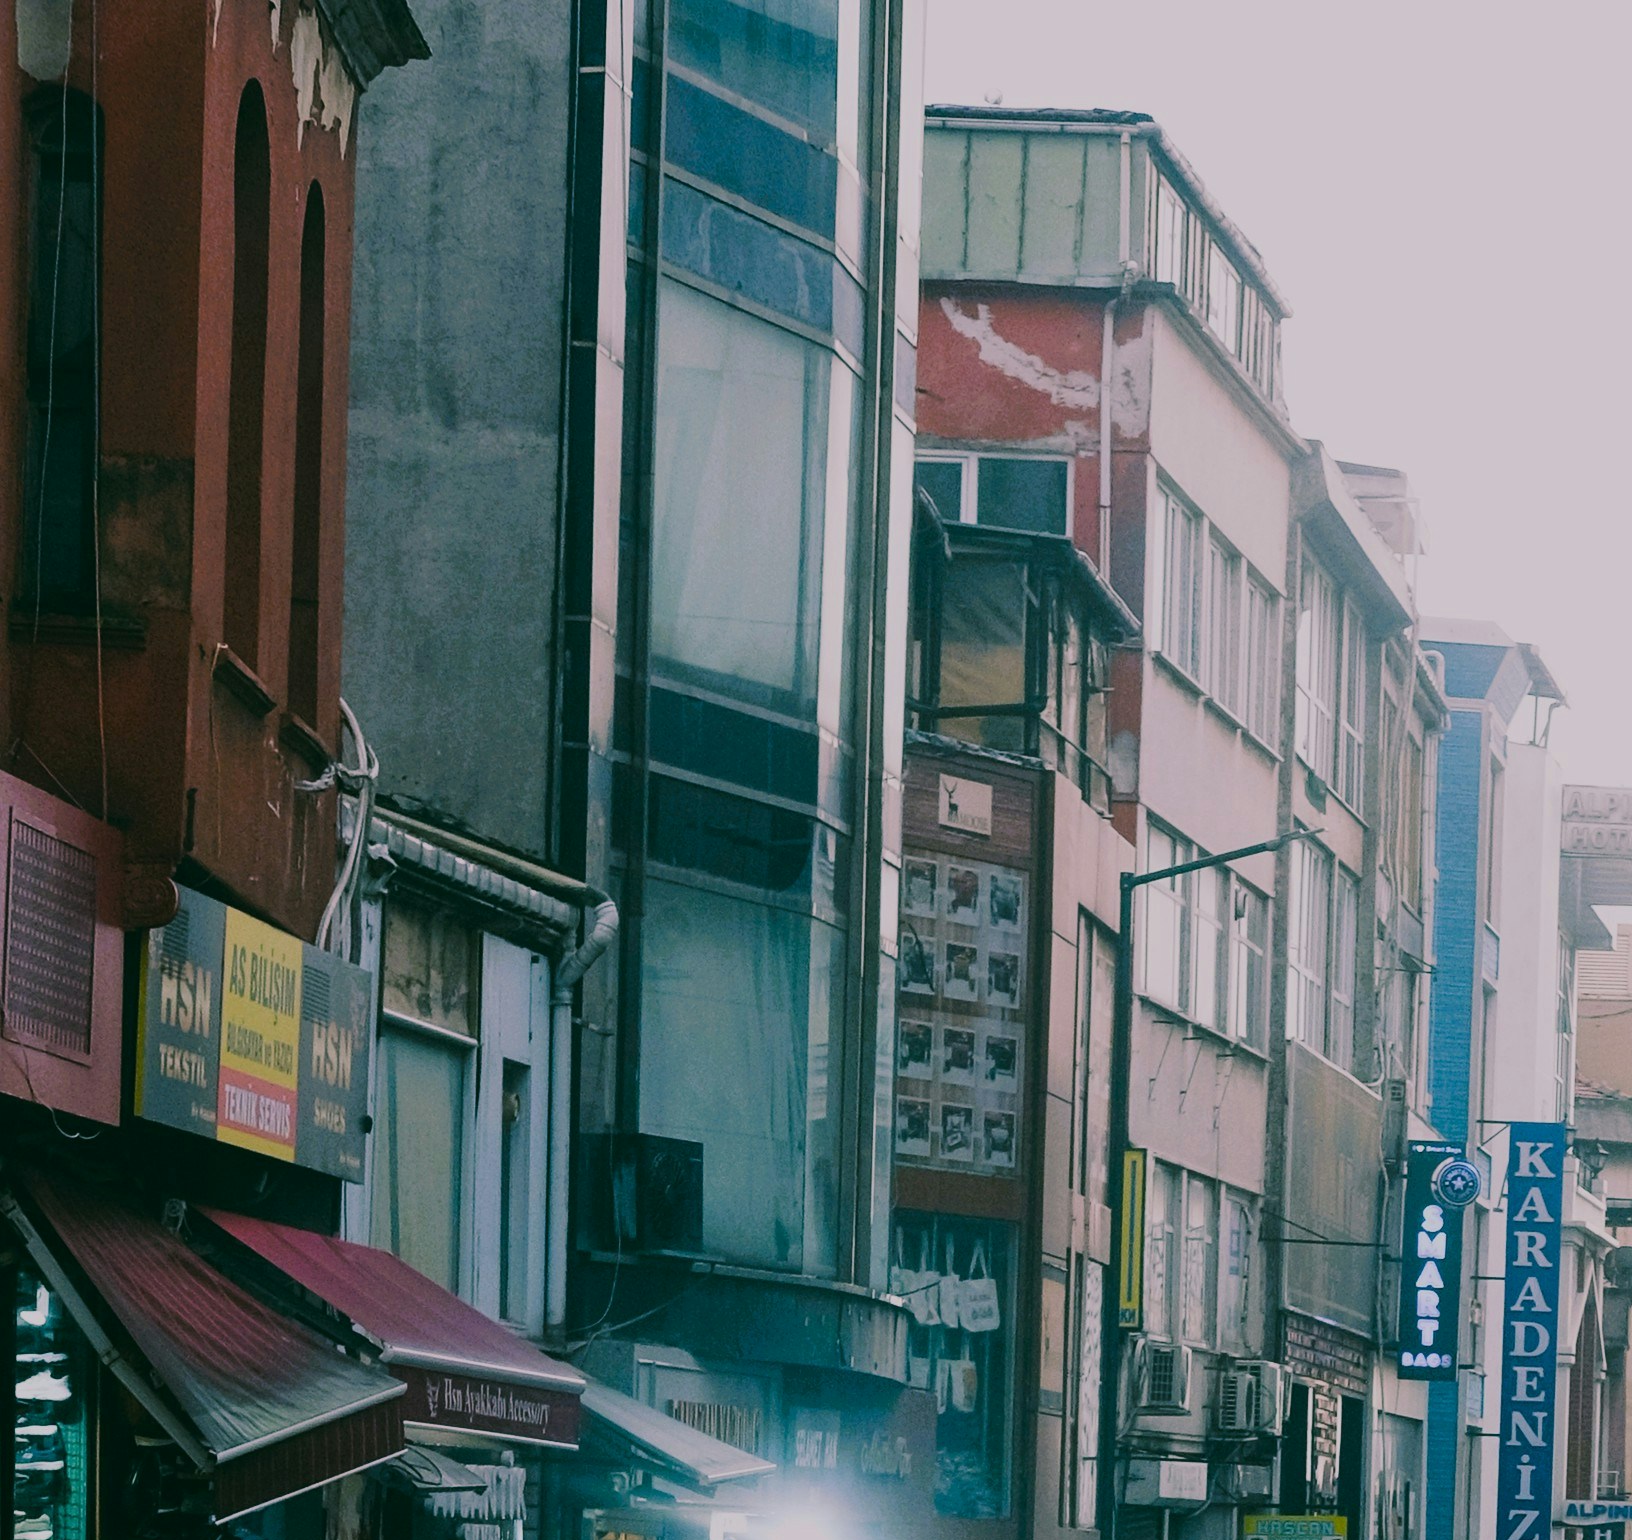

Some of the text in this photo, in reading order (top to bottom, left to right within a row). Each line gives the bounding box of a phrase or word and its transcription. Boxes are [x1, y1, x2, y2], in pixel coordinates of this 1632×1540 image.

[159, 958, 212, 1038] HSN
[229, 943, 247, 997] AS
[311, 1018, 352, 1089] HSN
[1415, 1204, 1447, 1347] SMART
[1401, 1351, 1452, 1369] BAGS
[444, 1377, 463, 1412] Hsn
